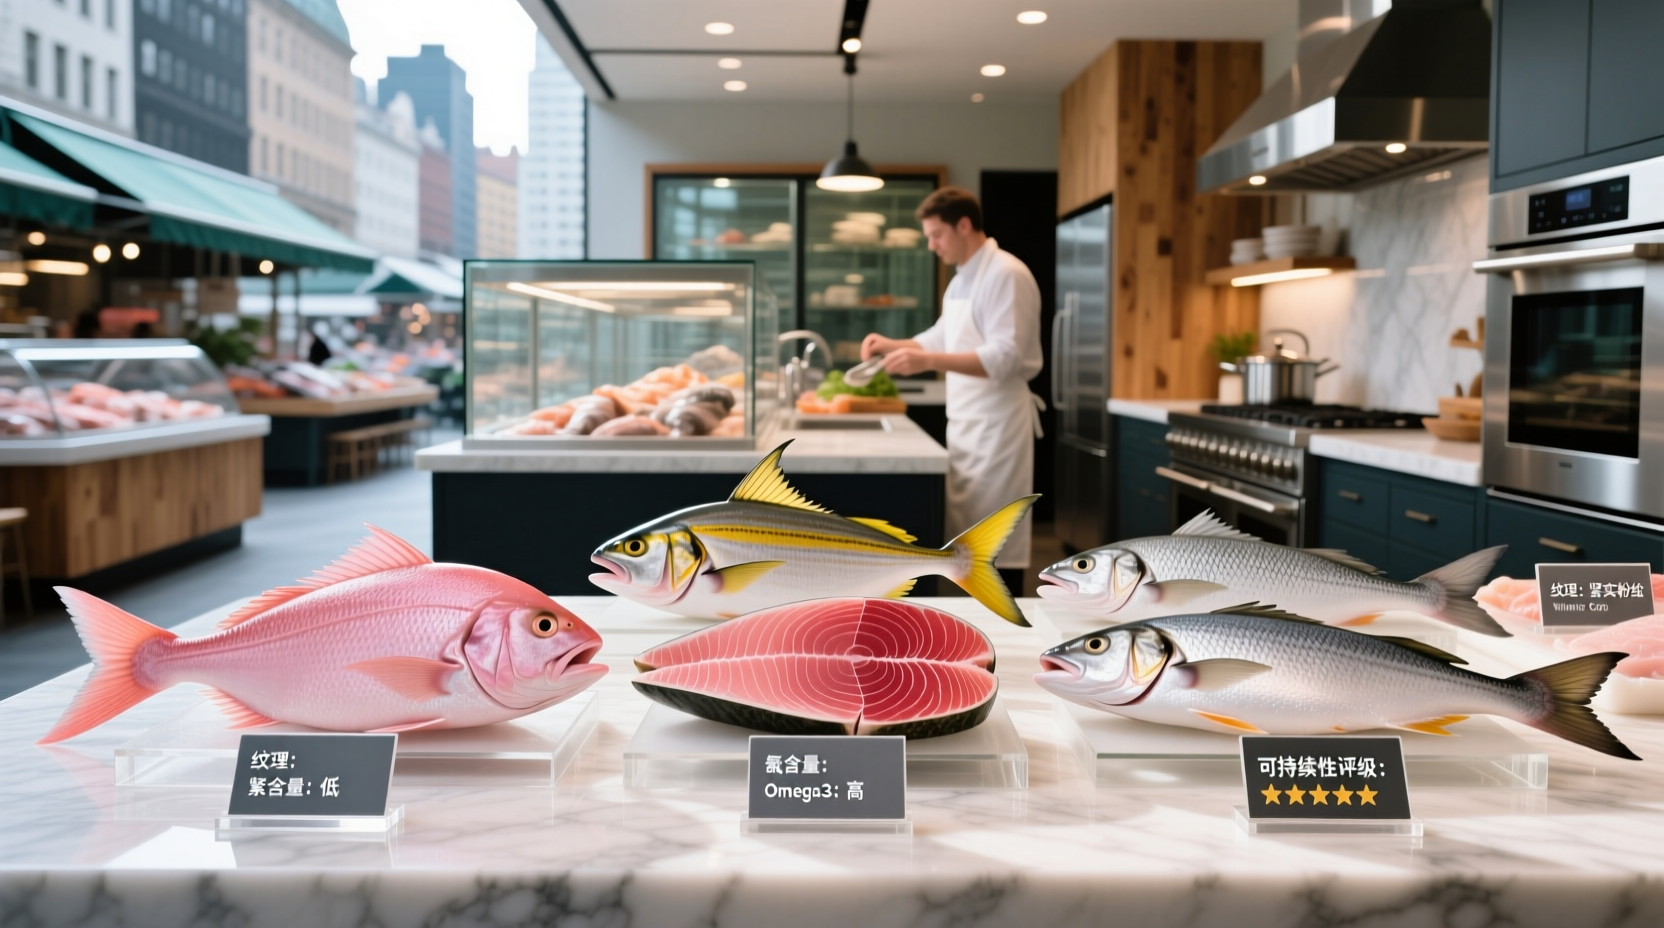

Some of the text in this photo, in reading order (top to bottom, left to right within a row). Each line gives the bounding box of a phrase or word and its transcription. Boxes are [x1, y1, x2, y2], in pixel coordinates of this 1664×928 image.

[250, 750, 296, 770] 纹理：
[1257, 755, 1386, 778] 可持续性评级：
